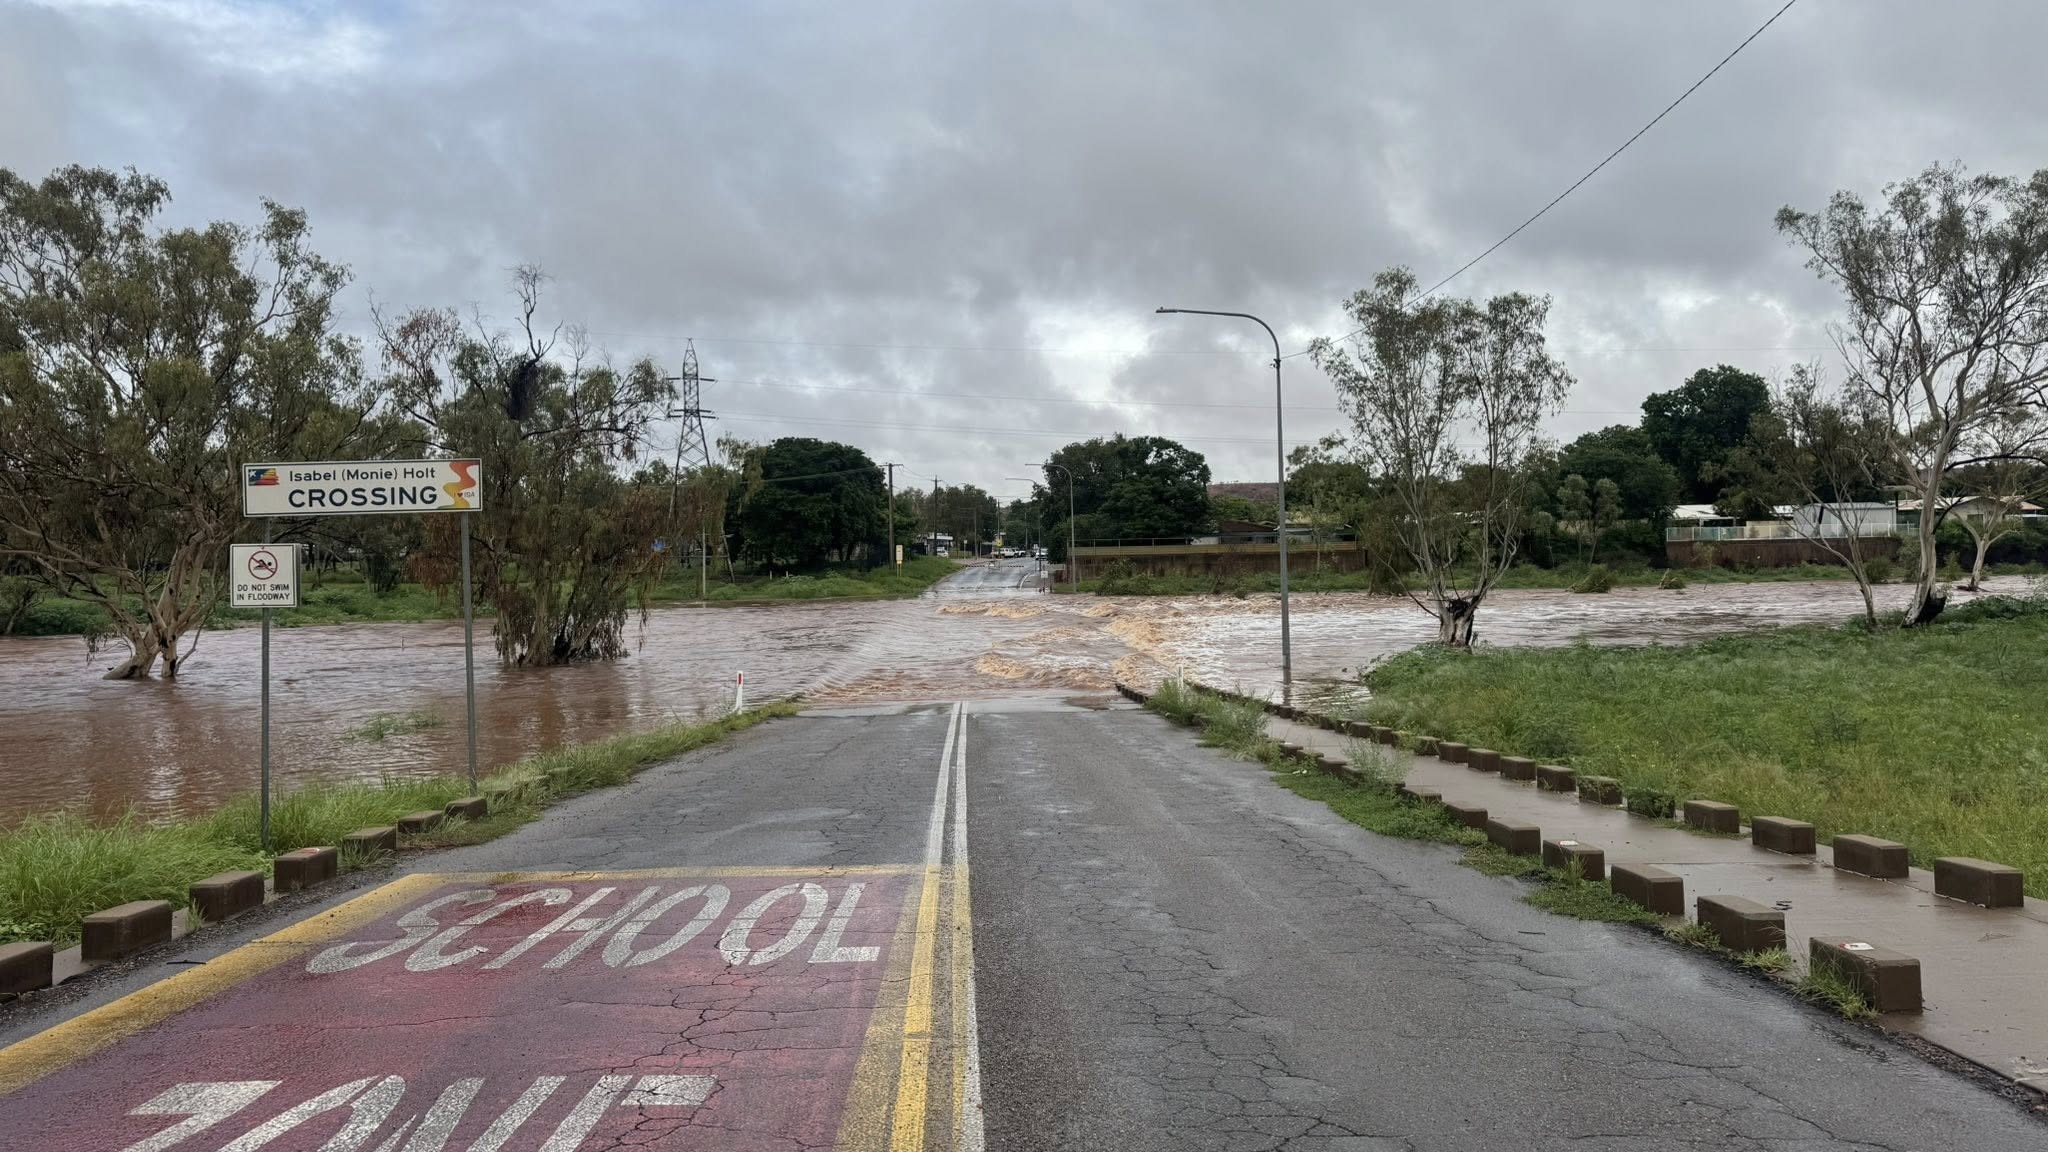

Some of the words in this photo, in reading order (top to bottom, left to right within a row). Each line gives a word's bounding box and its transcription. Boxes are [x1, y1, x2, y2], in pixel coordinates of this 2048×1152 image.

[289, 469, 336, 482] Isabel
[341, 467, 398, 482] (Monie)
[403, 467, 436, 480] Holt
[288, 486, 438, 508] CROSSING
[270, 583, 290, 591] SWIM
[305, 882, 881, 974] SCHOOL
